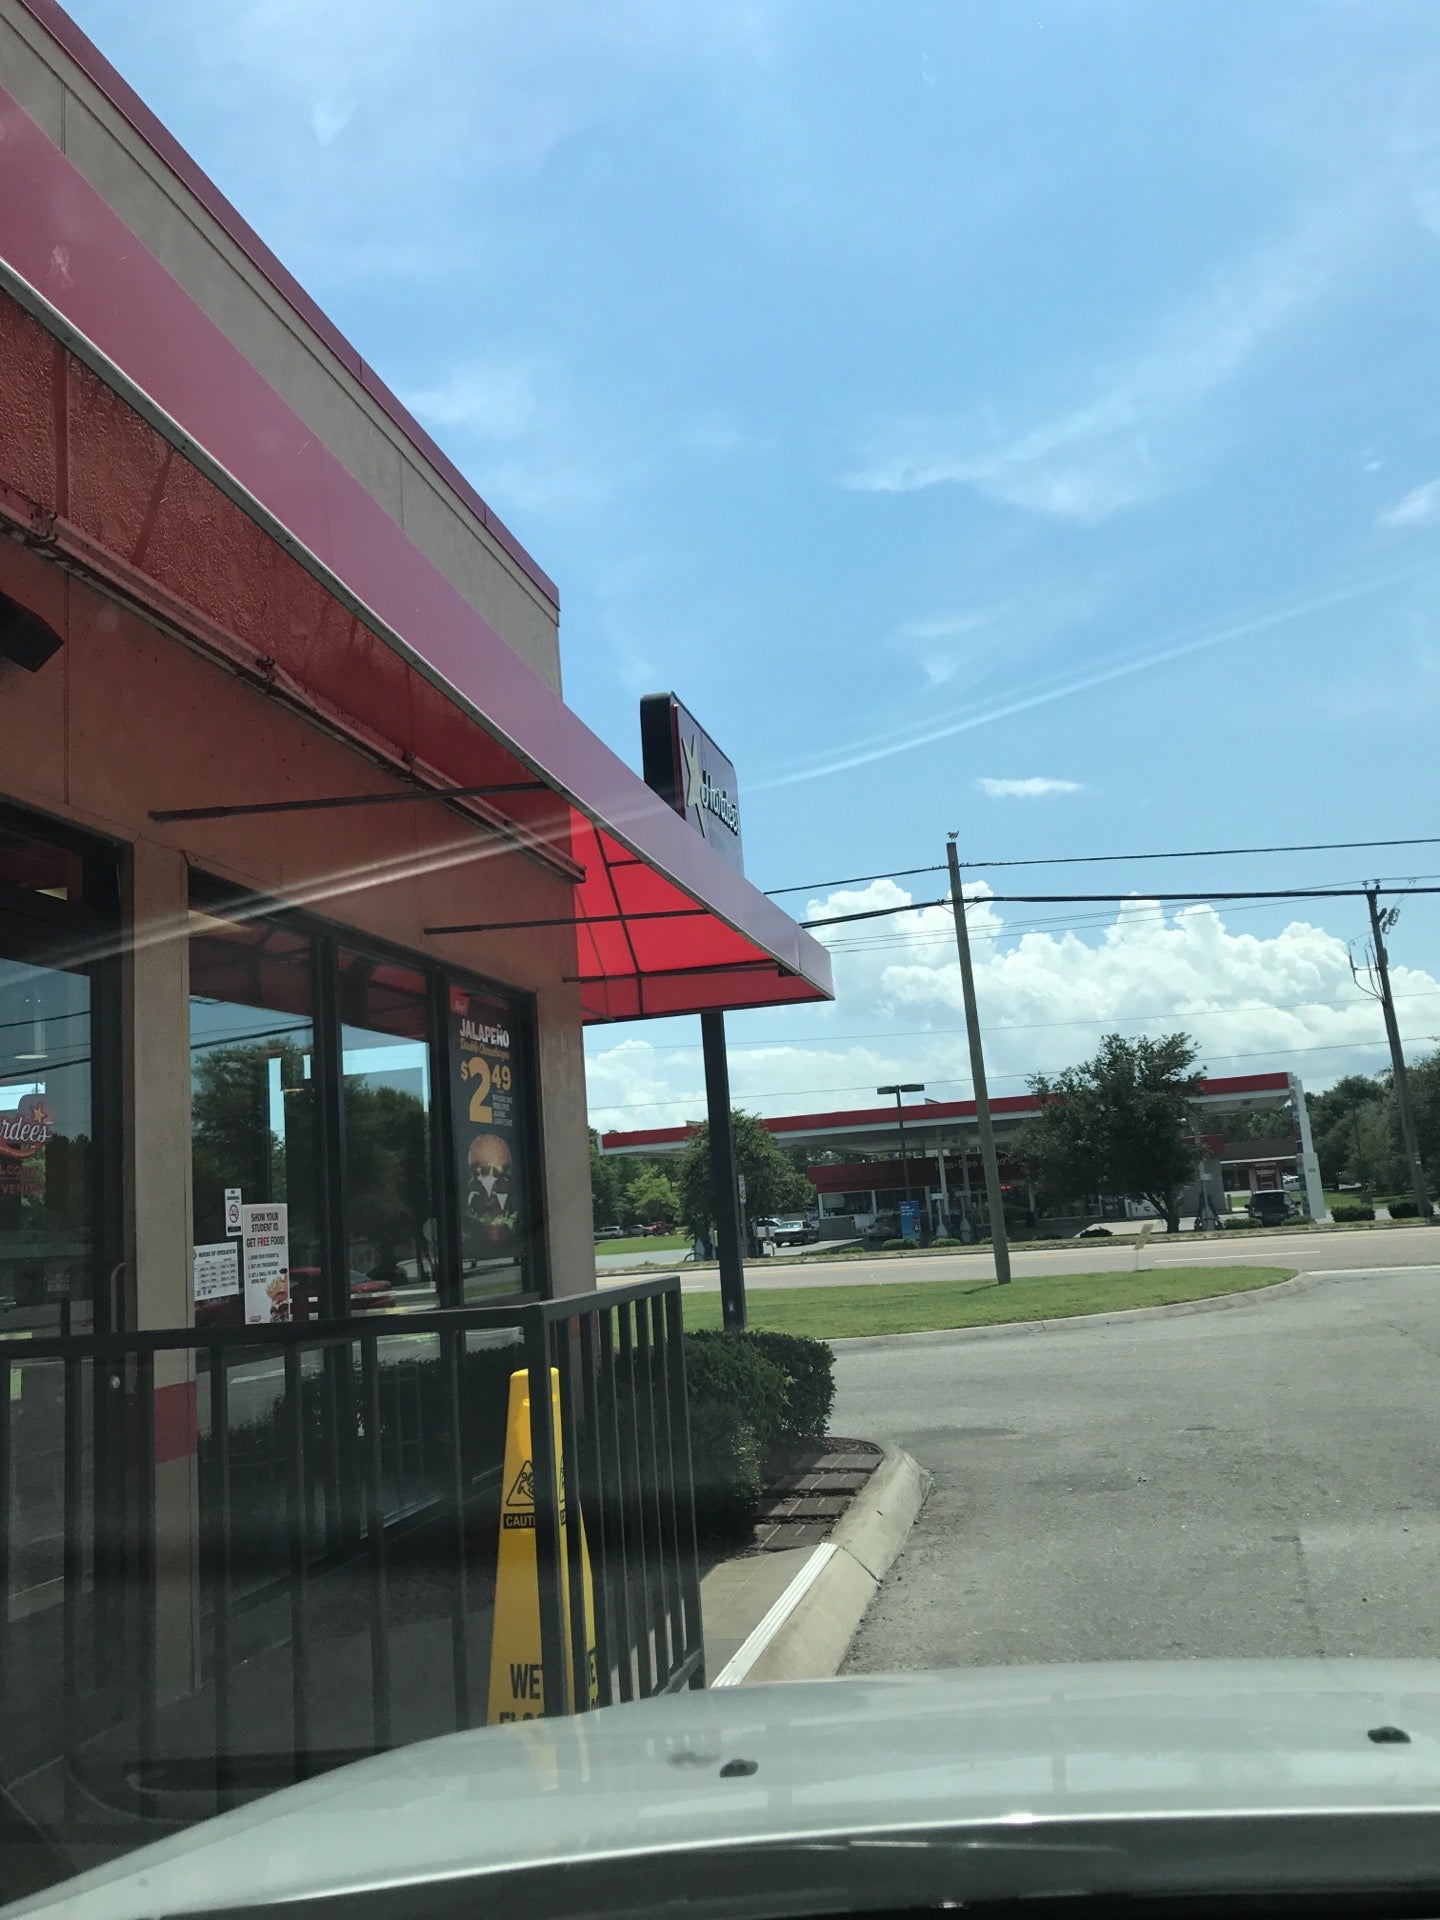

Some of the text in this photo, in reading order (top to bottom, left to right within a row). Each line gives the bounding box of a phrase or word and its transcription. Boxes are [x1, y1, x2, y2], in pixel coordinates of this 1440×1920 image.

[460, 1018, 510, 1048] JALAPEÑO
[251, 1212, 279, 1222] SHOW YOUR
[251, 1223, 272, 1232] STUDENT
[246, 1237, 256, 1248] GET
[257, 1236, 270, 1247] FREE
[510, 1663, 544, 1700] WE
